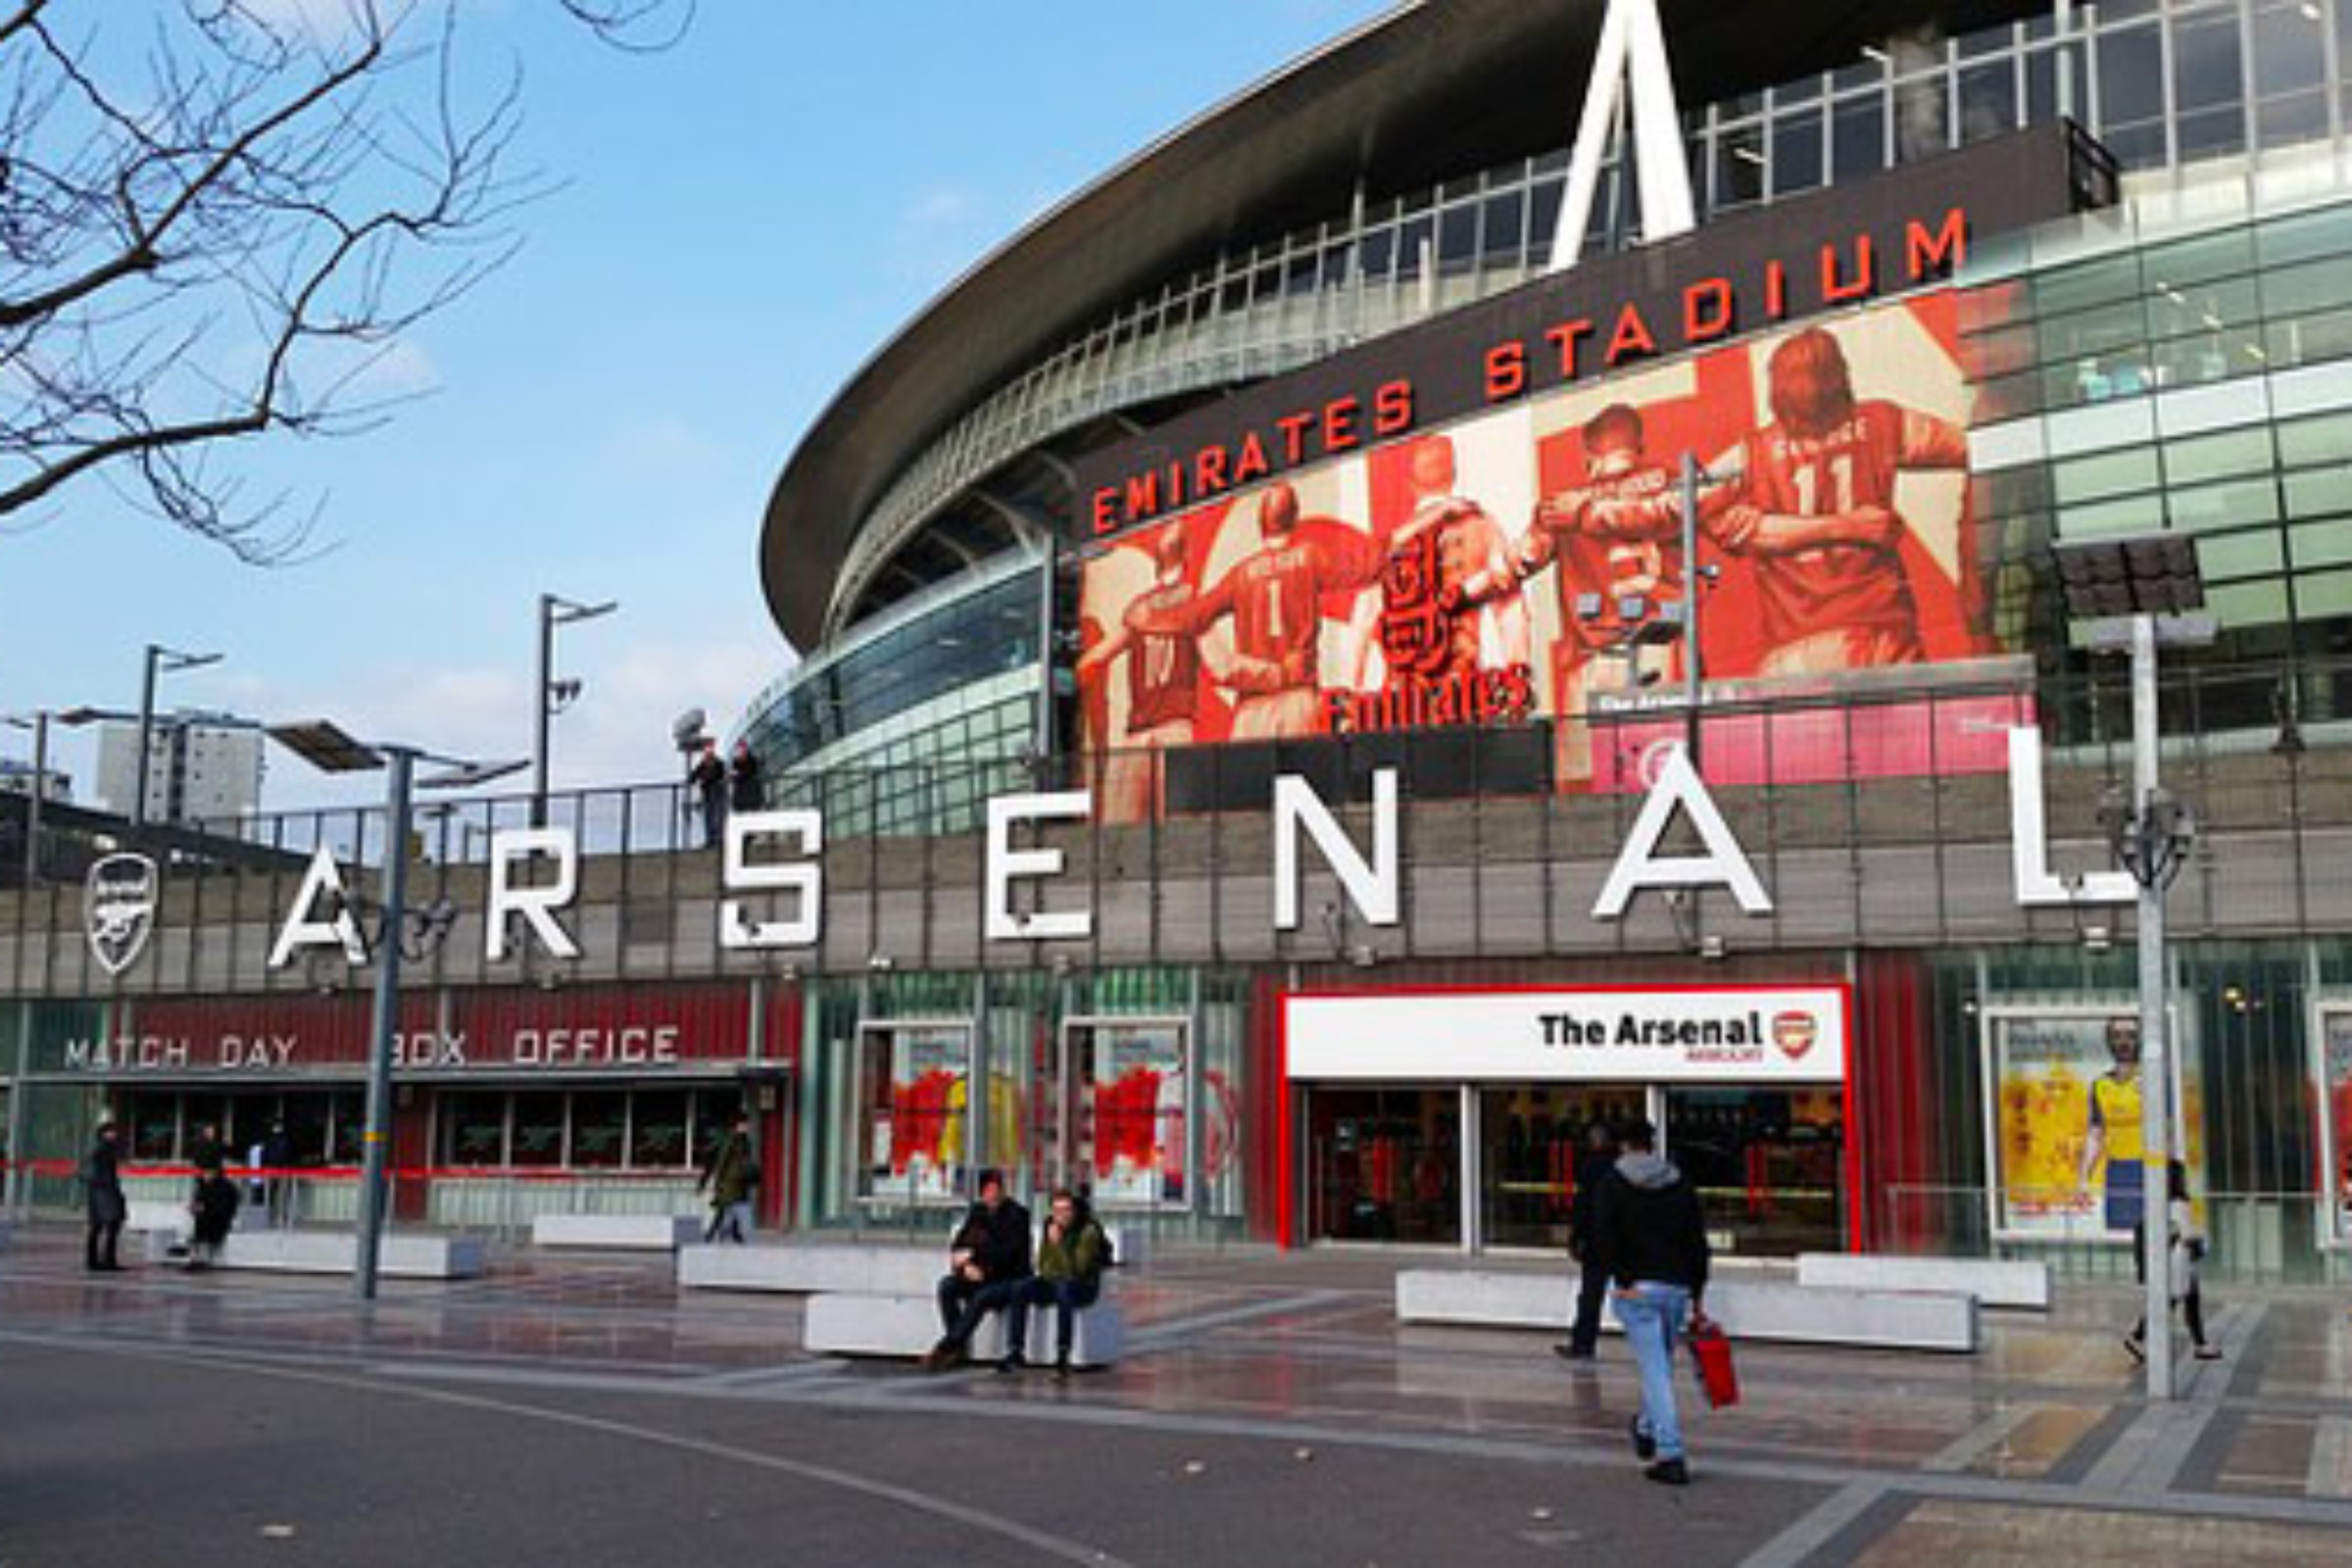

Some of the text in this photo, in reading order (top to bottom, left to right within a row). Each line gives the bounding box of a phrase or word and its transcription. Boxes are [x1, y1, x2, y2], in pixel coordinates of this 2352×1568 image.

[1093, 208, 1966, 534] EMIRATES STADIUM
[1791, 452, 1852, 517] 11
[268, 723, 2138, 966] ARSENAL
[64, 1037, 188, 1069] MATCH
[220, 1035, 297, 1068] DAY
[514, 1026, 679, 1064] OFFICE
[1539, 1010, 1762, 1046] The Arsenal
